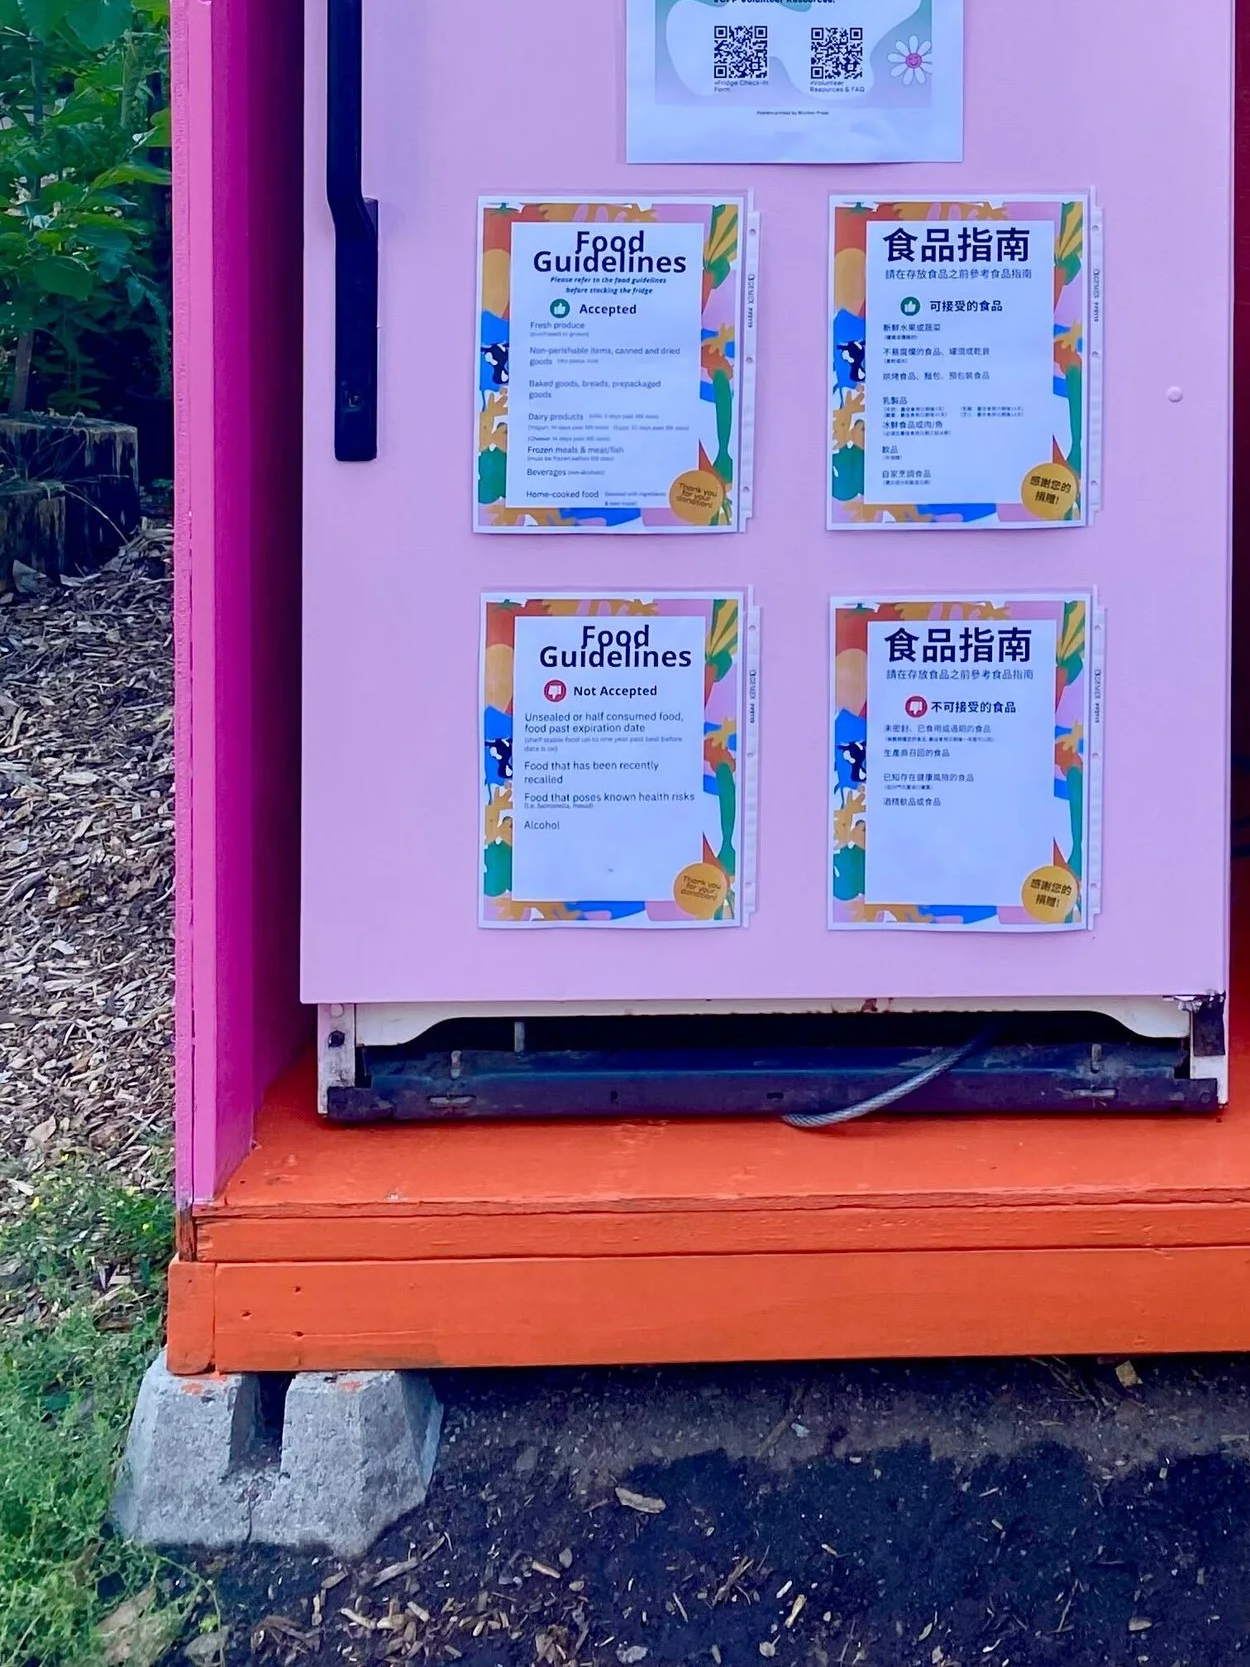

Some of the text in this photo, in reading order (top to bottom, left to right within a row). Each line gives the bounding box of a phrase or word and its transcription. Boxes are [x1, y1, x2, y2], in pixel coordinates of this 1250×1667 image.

[576, 231, 644, 253] Food
[883, 227, 1030, 263] 食品指南
[533, 251, 686, 273] Guidelines
[614, 277, 630, 285] food
[632, 277, 667, 285] guidelines
[632, 287, 653, 295] fridge
[579, 304, 637, 317] Accepted
[930, 300, 1003, 312] 可接受的食品
[554, 322, 585, 330] produce
[528, 413, 548, 421] Dairy
[528, 446, 555, 454] Frozen
[527, 469, 566, 477] Beverages
[582, 625, 649, 647] Food
[884, 627, 1032, 663] 食品指南
[540, 646, 692, 668] Guidelines
[574, 686, 657, 698] Not Accepted
[931, 701, 1016, 714] 不可接受的食品
[525, 713, 684, 722] Unsealed or half consumed food,
[525, 724, 645, 735] food past expiration date
[524, 761, 659, 771] Food that has been recently
[524, 775, 563, 784] recalled
[524, 792, 695, 803] Food that poses known health risks
[524, 821, 560, 830] Alcohol
